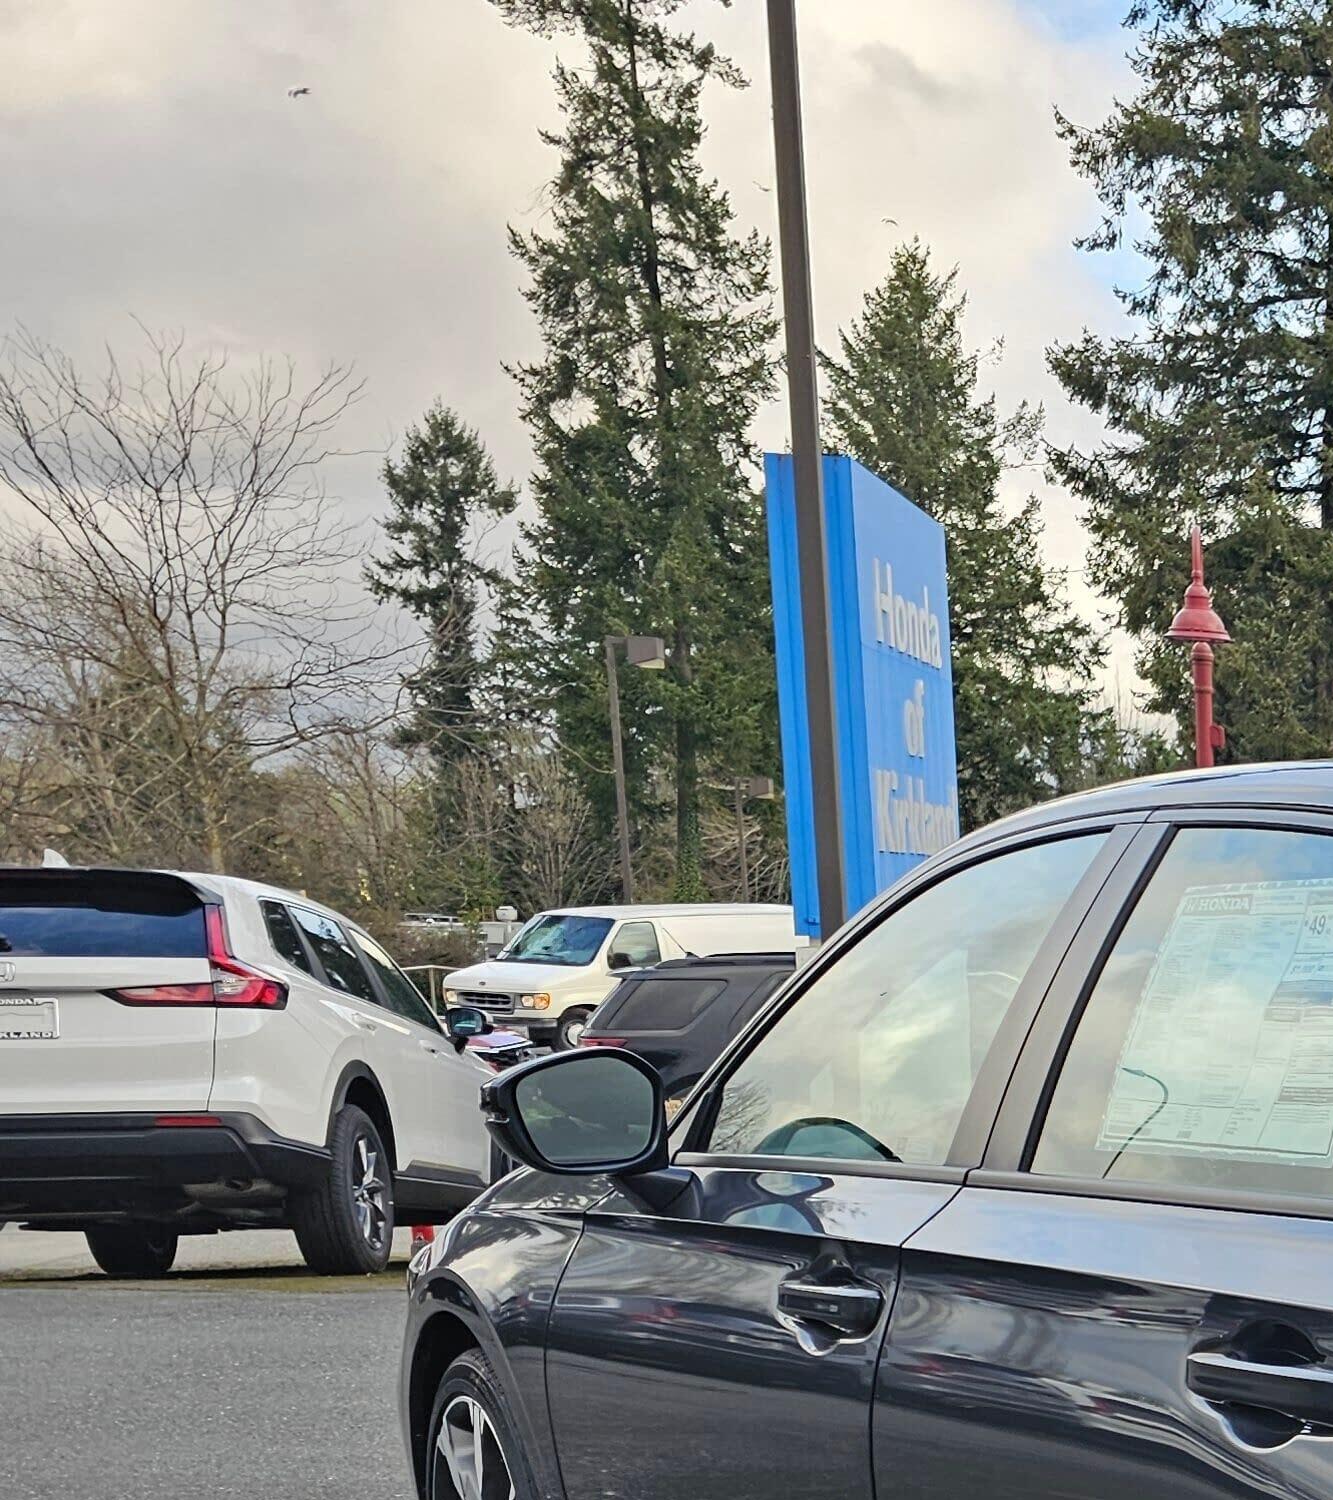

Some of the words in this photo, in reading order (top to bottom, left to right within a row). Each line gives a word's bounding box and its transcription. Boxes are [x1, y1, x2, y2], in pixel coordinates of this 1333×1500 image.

[873, 557, 941, 668] Honda
[904, 679, 925, 758] of
[1198, 896, 1250, 911] HONDA
